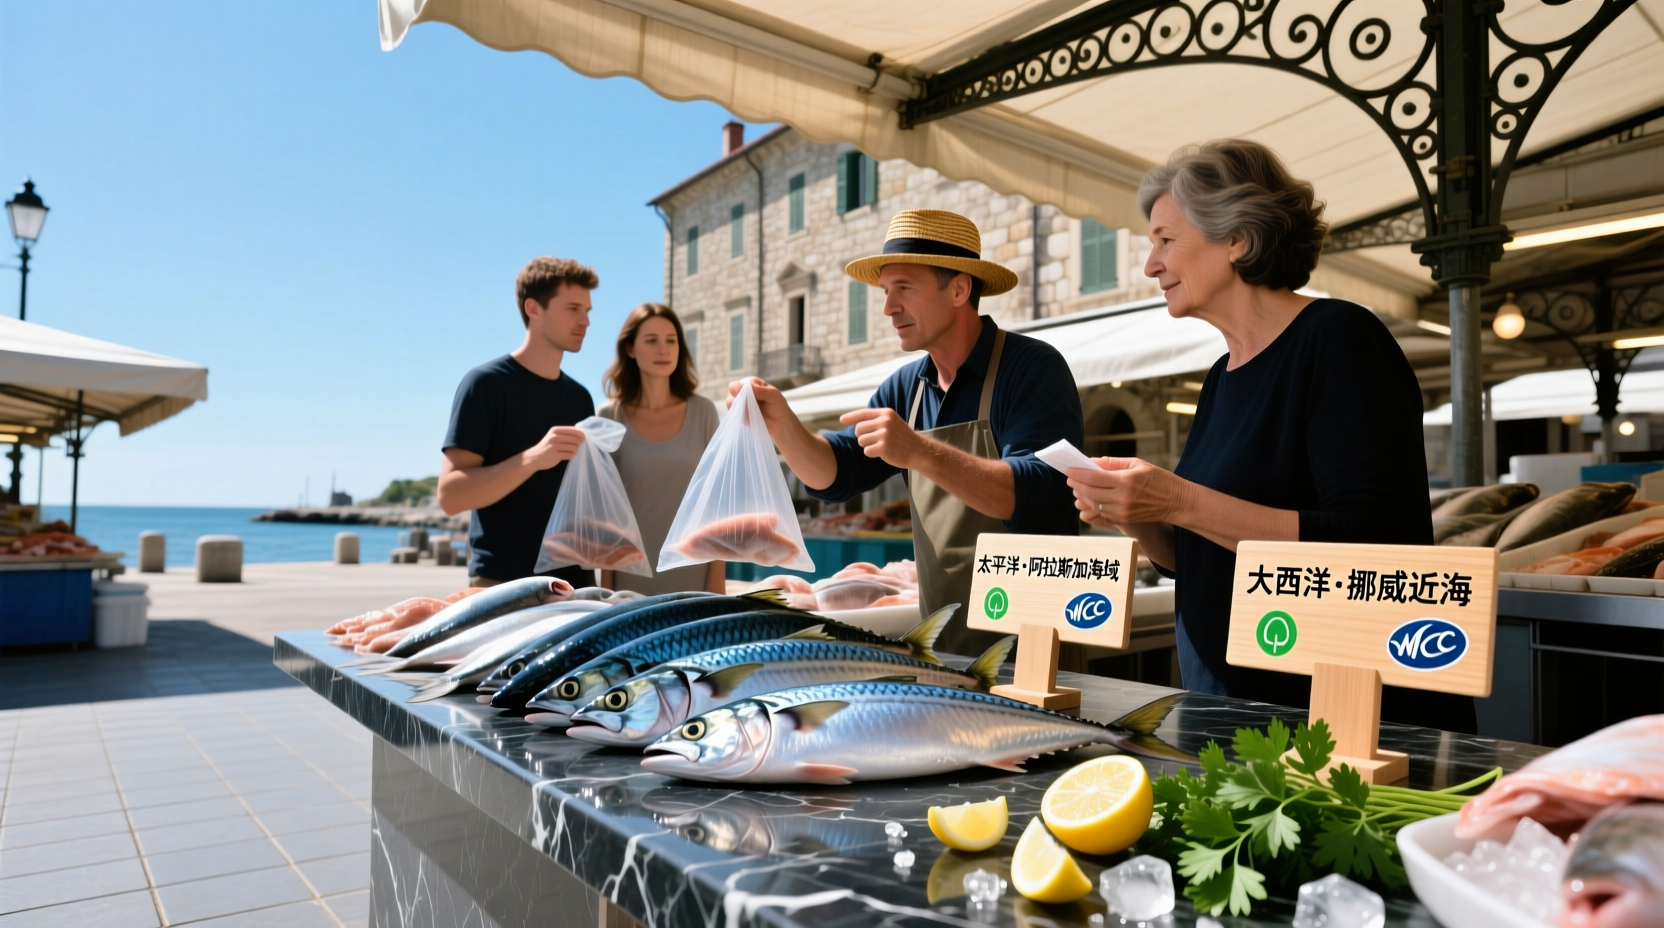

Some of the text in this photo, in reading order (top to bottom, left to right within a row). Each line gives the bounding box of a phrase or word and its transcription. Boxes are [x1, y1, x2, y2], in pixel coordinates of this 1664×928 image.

[1246, 564, 1473, 606] 大西洋·挪威近海
